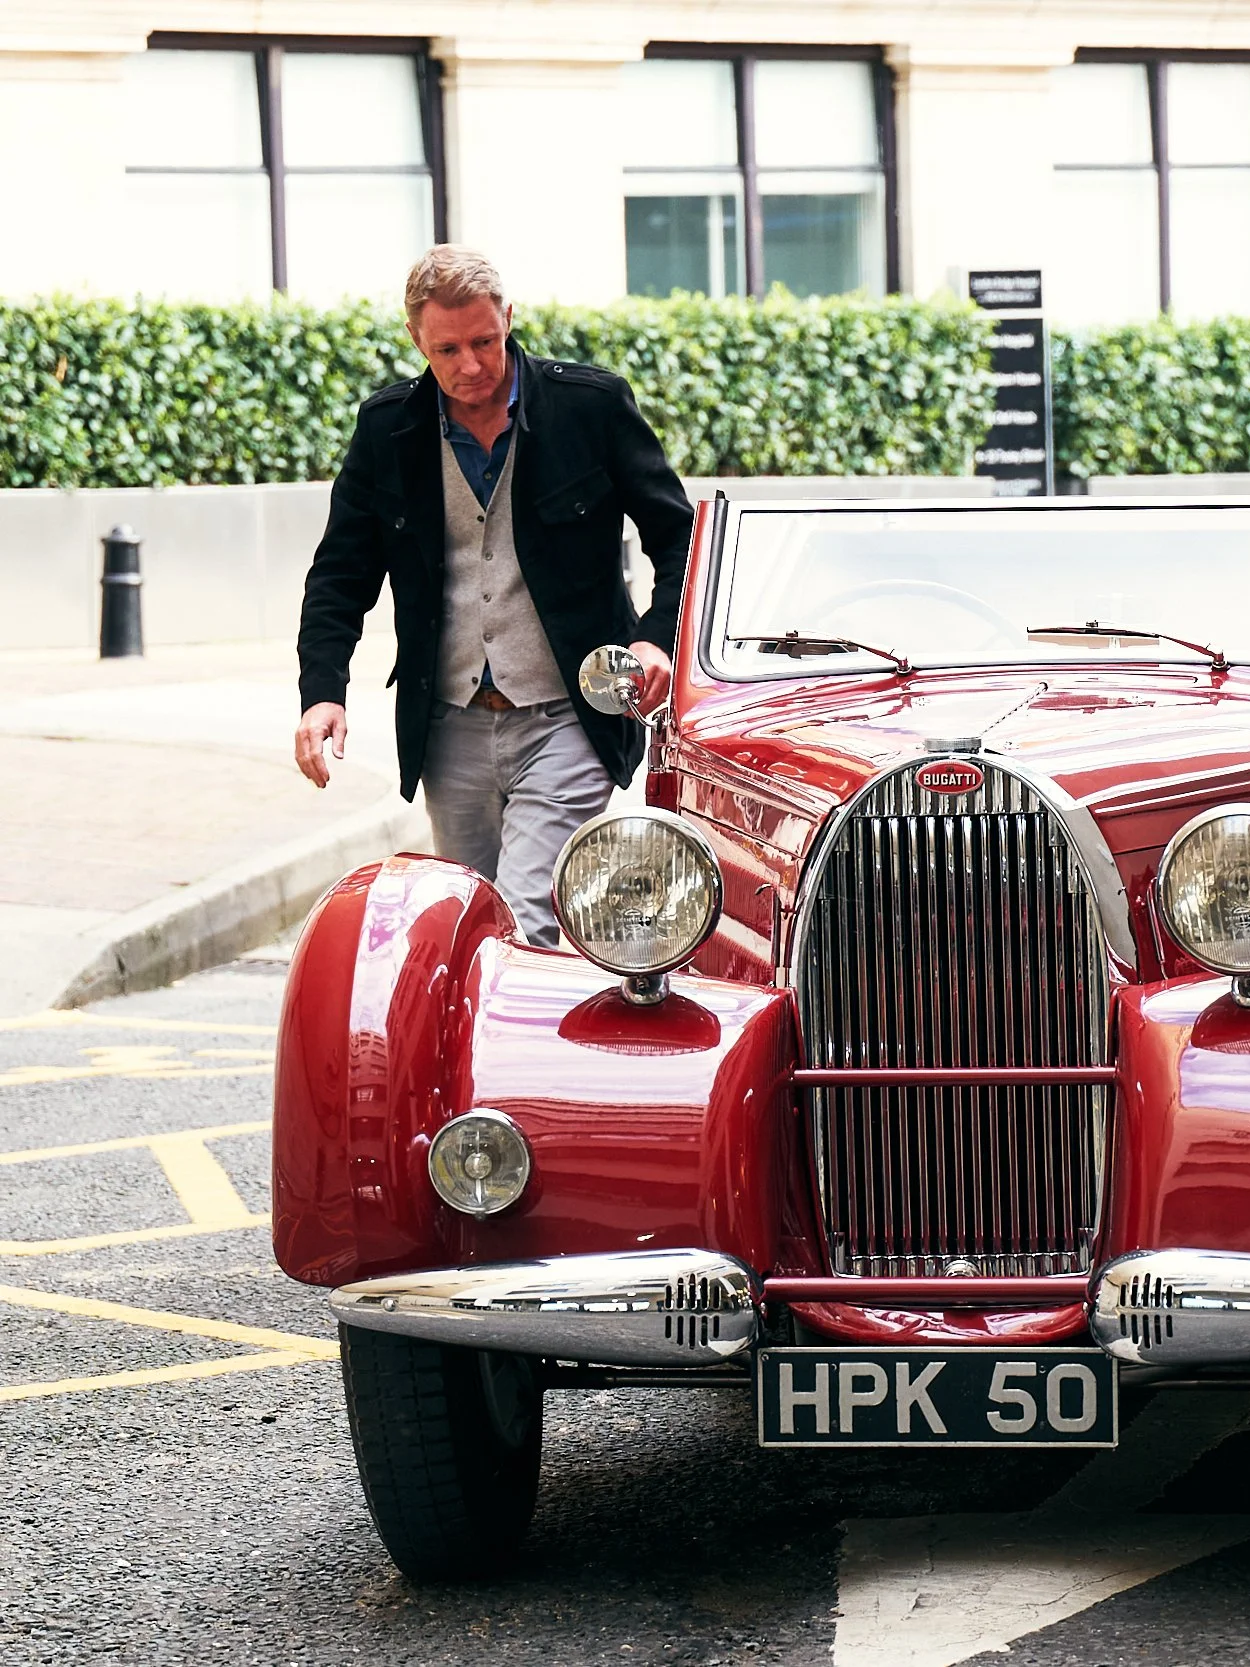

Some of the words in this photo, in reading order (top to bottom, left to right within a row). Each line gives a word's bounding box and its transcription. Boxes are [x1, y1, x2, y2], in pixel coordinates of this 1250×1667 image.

[923, 773, 976, 786] BUGATTI
[779, 1361, 948, 1434] HPK
[986, 1361, 1098, 1434] 50
